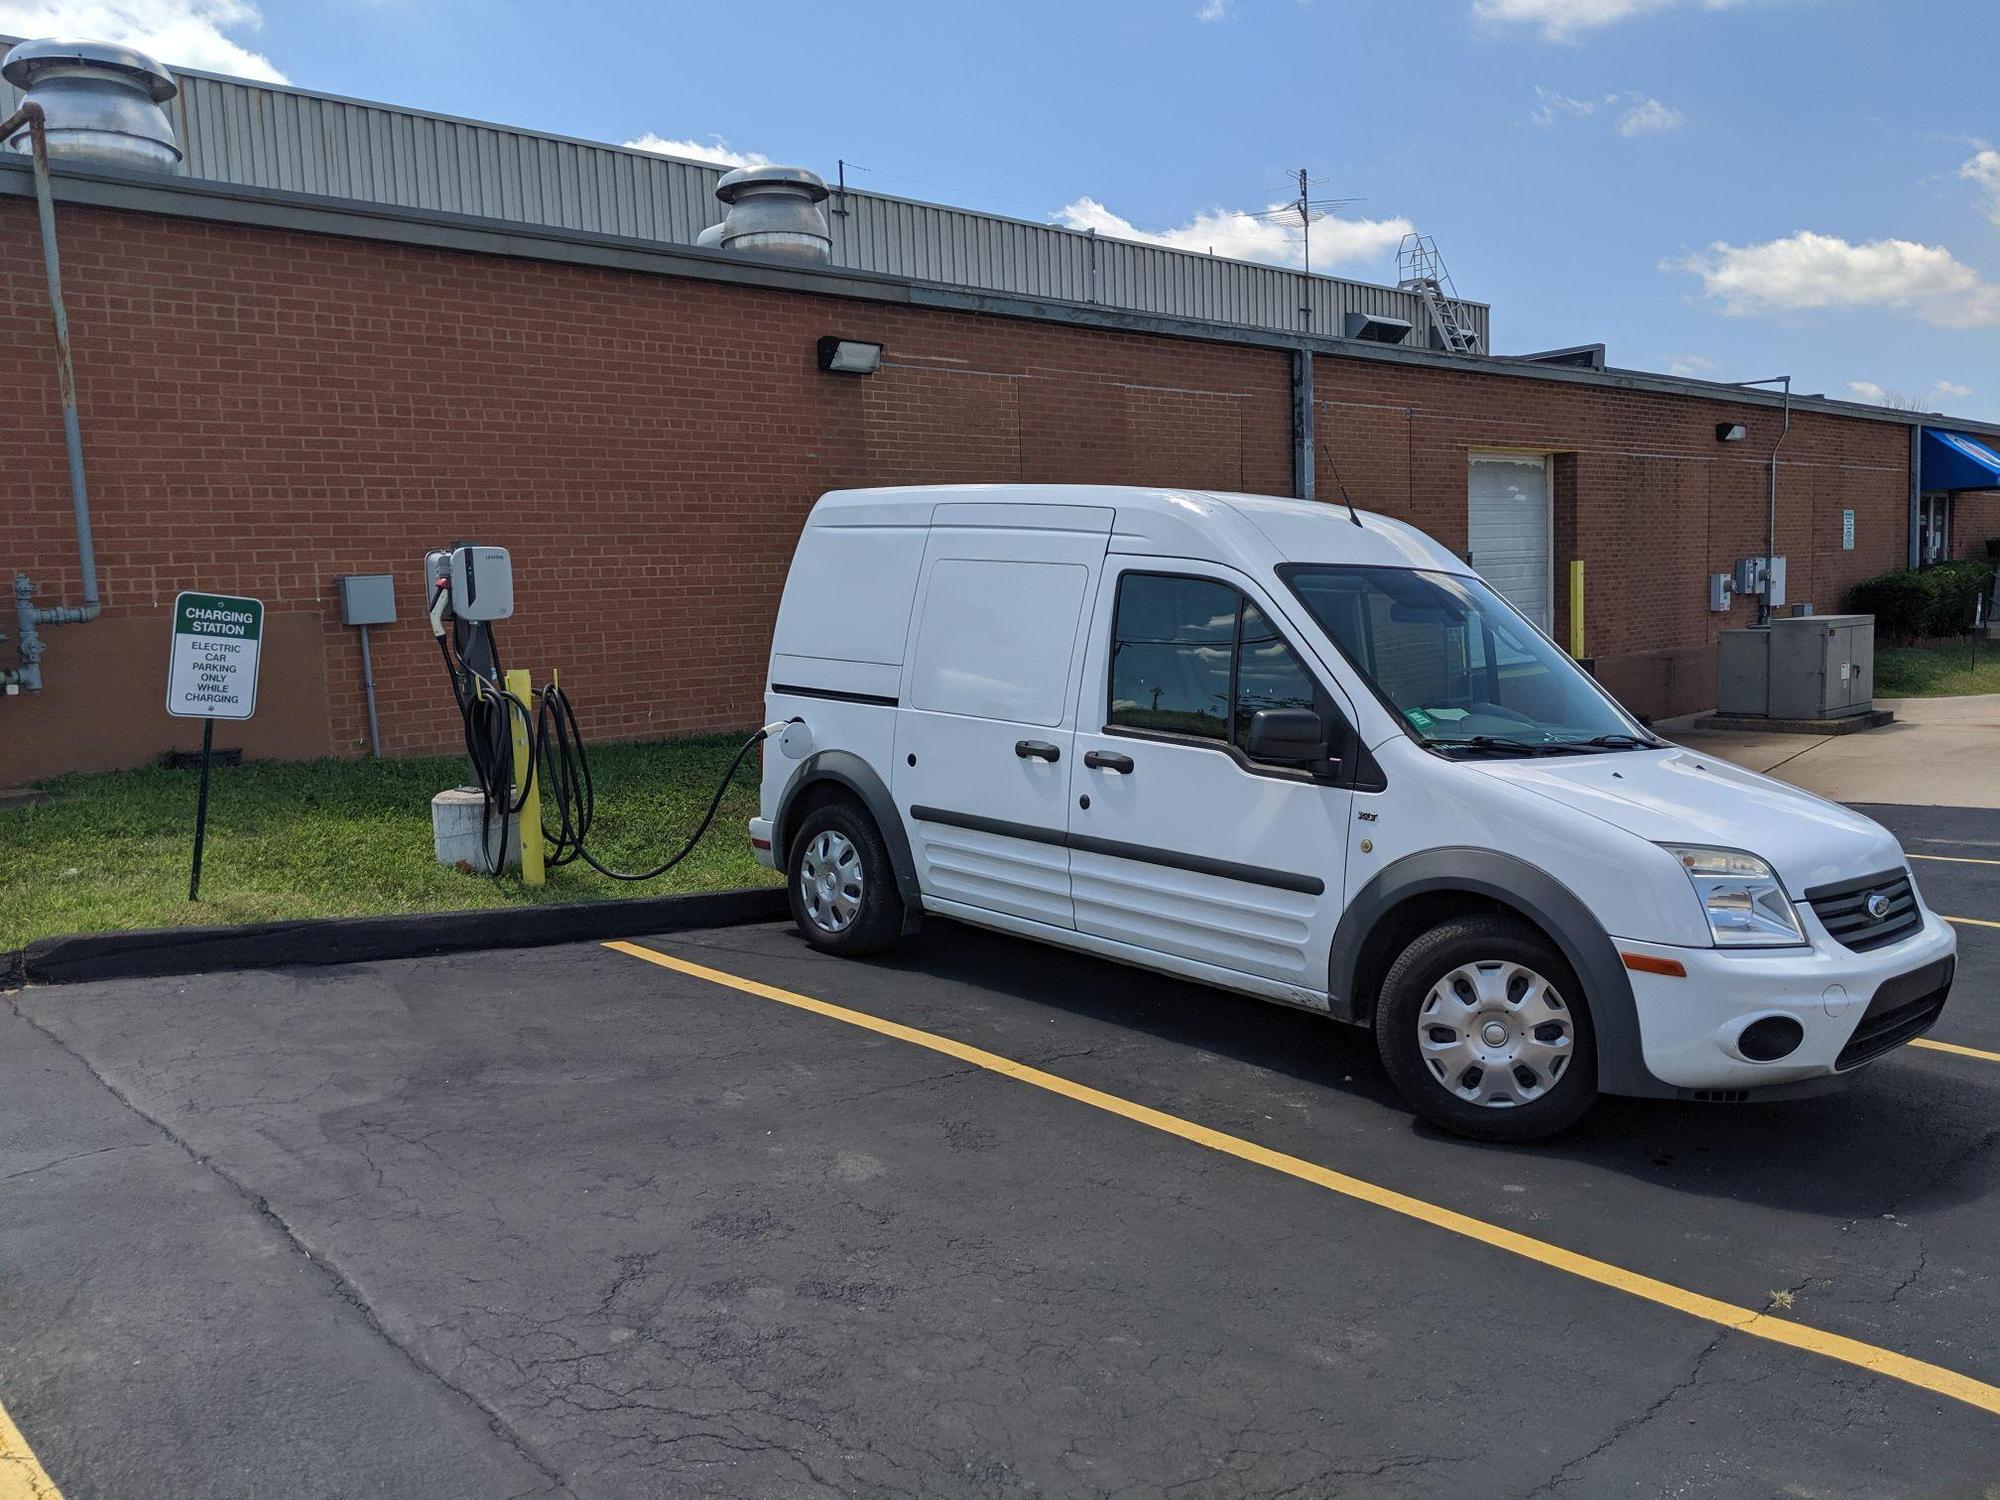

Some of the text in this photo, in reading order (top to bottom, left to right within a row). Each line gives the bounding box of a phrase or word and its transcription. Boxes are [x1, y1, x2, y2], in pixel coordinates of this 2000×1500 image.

[186, 607, 253, 623] CHARGING
[192, 621, 245, 635] STATION
[191, 641, 241, 653] ELECTRIC
[205, 653, 227, 662] CAR
[192, 662, 237, 673] PARKING
[201, 673, 227, 682] ONLY
[197, 684, 229, 692] WHILE
[185, 692, 239, 704] CHARGING
